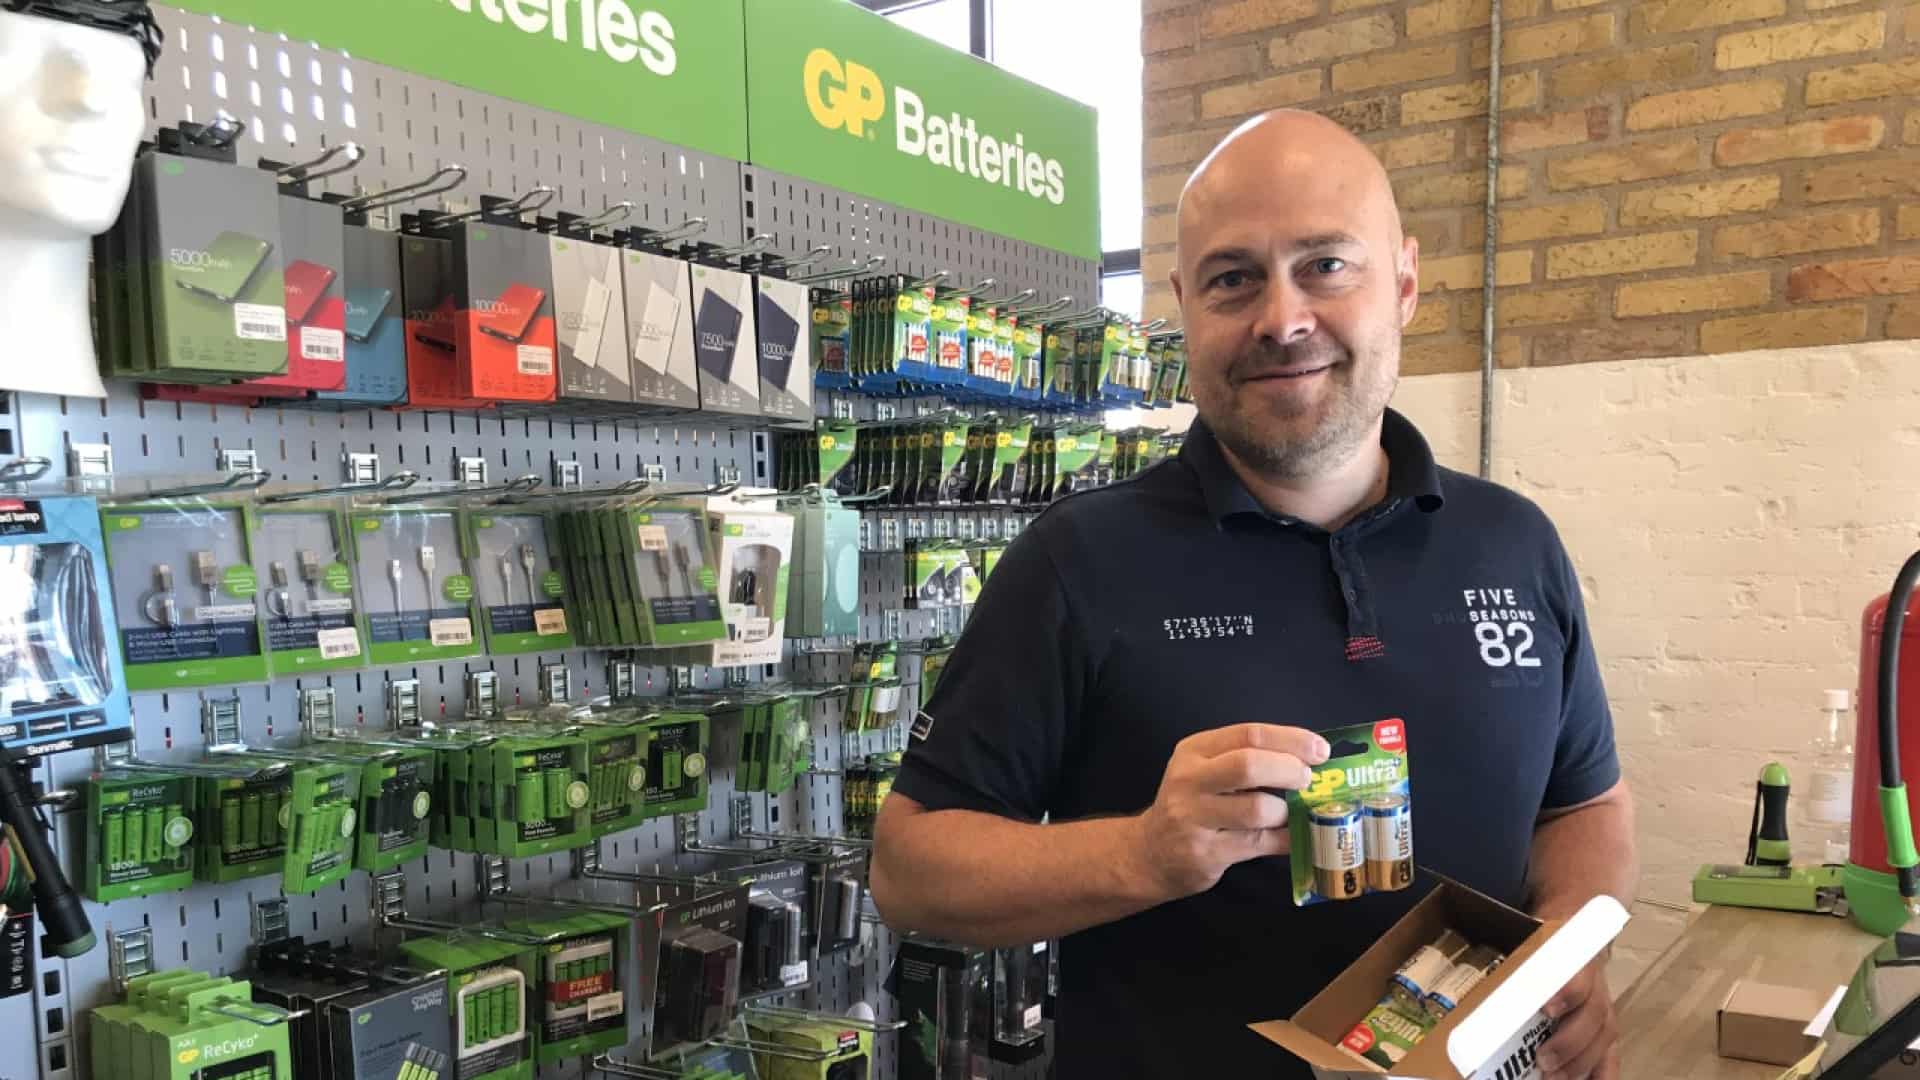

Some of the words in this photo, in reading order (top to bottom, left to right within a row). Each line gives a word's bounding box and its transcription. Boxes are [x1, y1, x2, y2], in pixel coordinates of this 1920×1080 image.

[803, 48, 885, 138] GP
[895, 85, 1065, 205] Batteries
[1463, 588, 1517, 607] FIVE
[1469, 608, 1536, 622] SEASONS
[1474, 621, 1542, 667] 82
[1346, 764, 1397, 788] Ultra
[692, 902, 723, 920] Lithium
[724, 897, 736, 910] Ion
[569, 975, 603, 992] FREE
